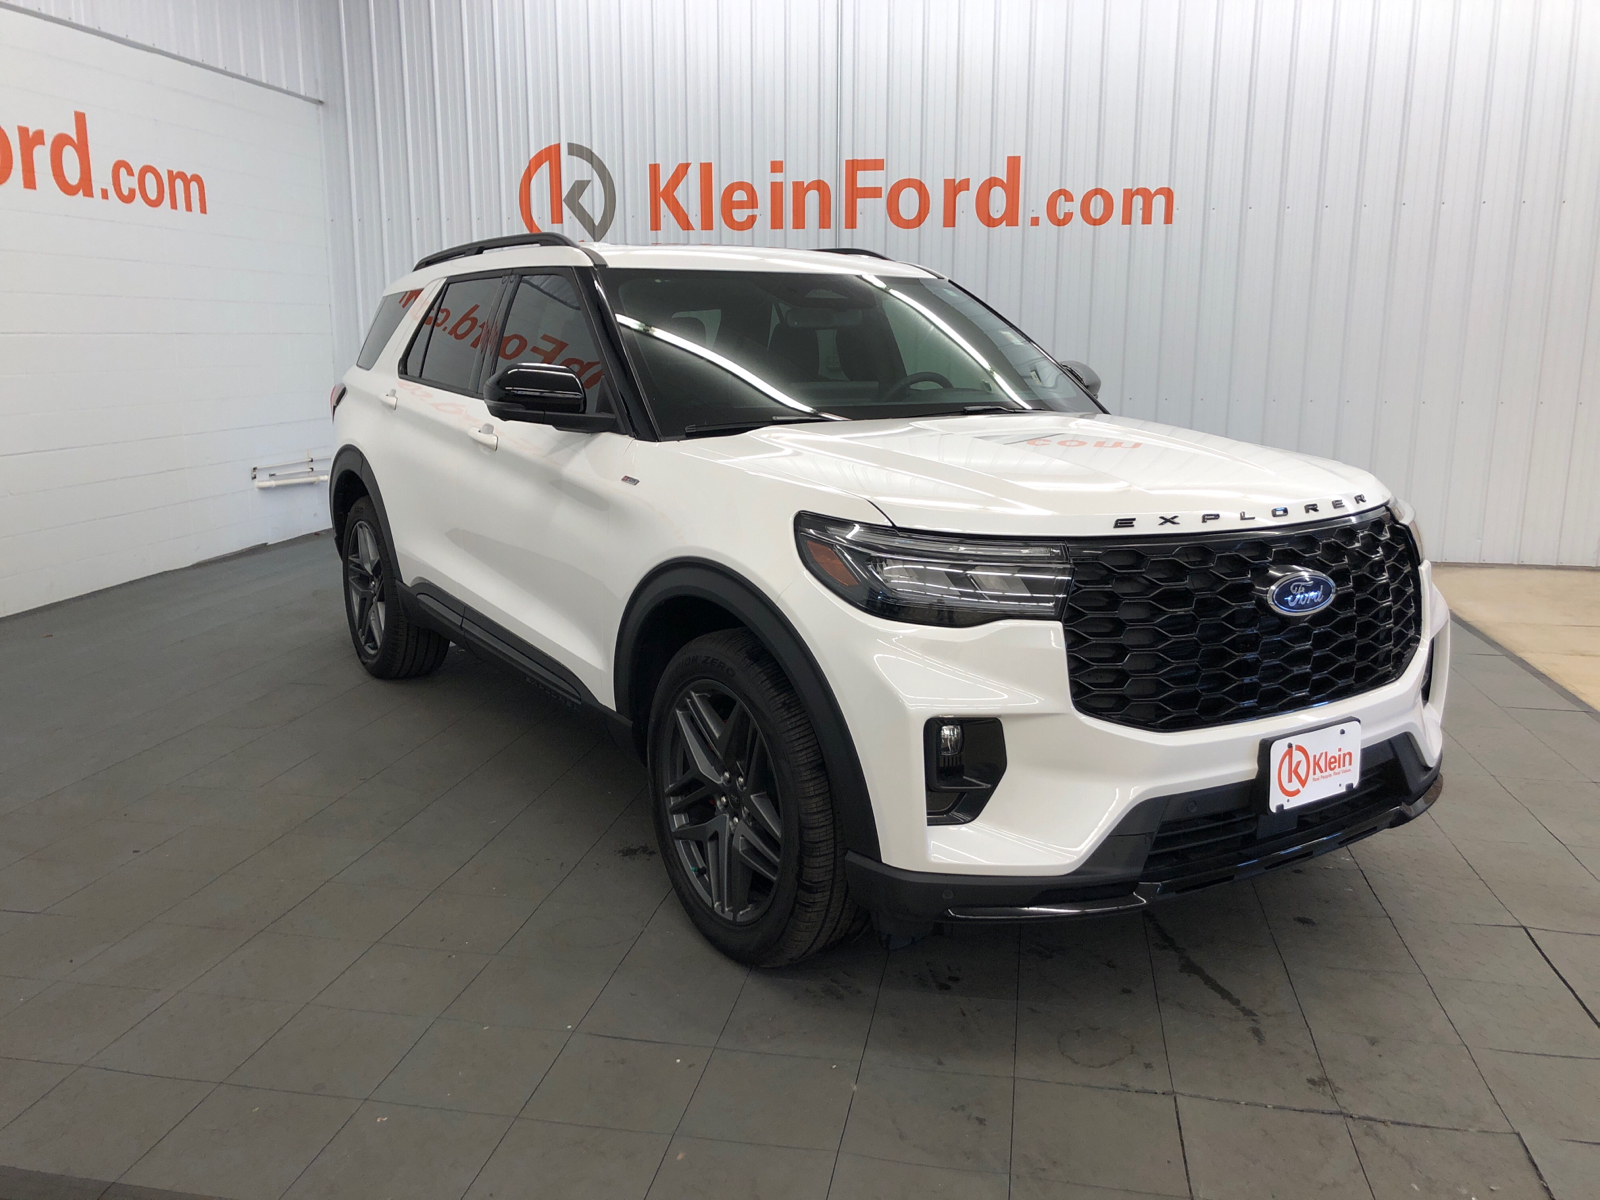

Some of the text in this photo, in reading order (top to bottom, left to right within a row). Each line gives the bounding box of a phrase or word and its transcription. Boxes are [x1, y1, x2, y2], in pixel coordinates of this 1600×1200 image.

[649, 155, 1175, 232] KleinFord.com
[1113, 493, 1367, 529] EXPLORER
[1284, 581, 1325, 607] Ford
[1312, 747, 1353, 776] Klein
